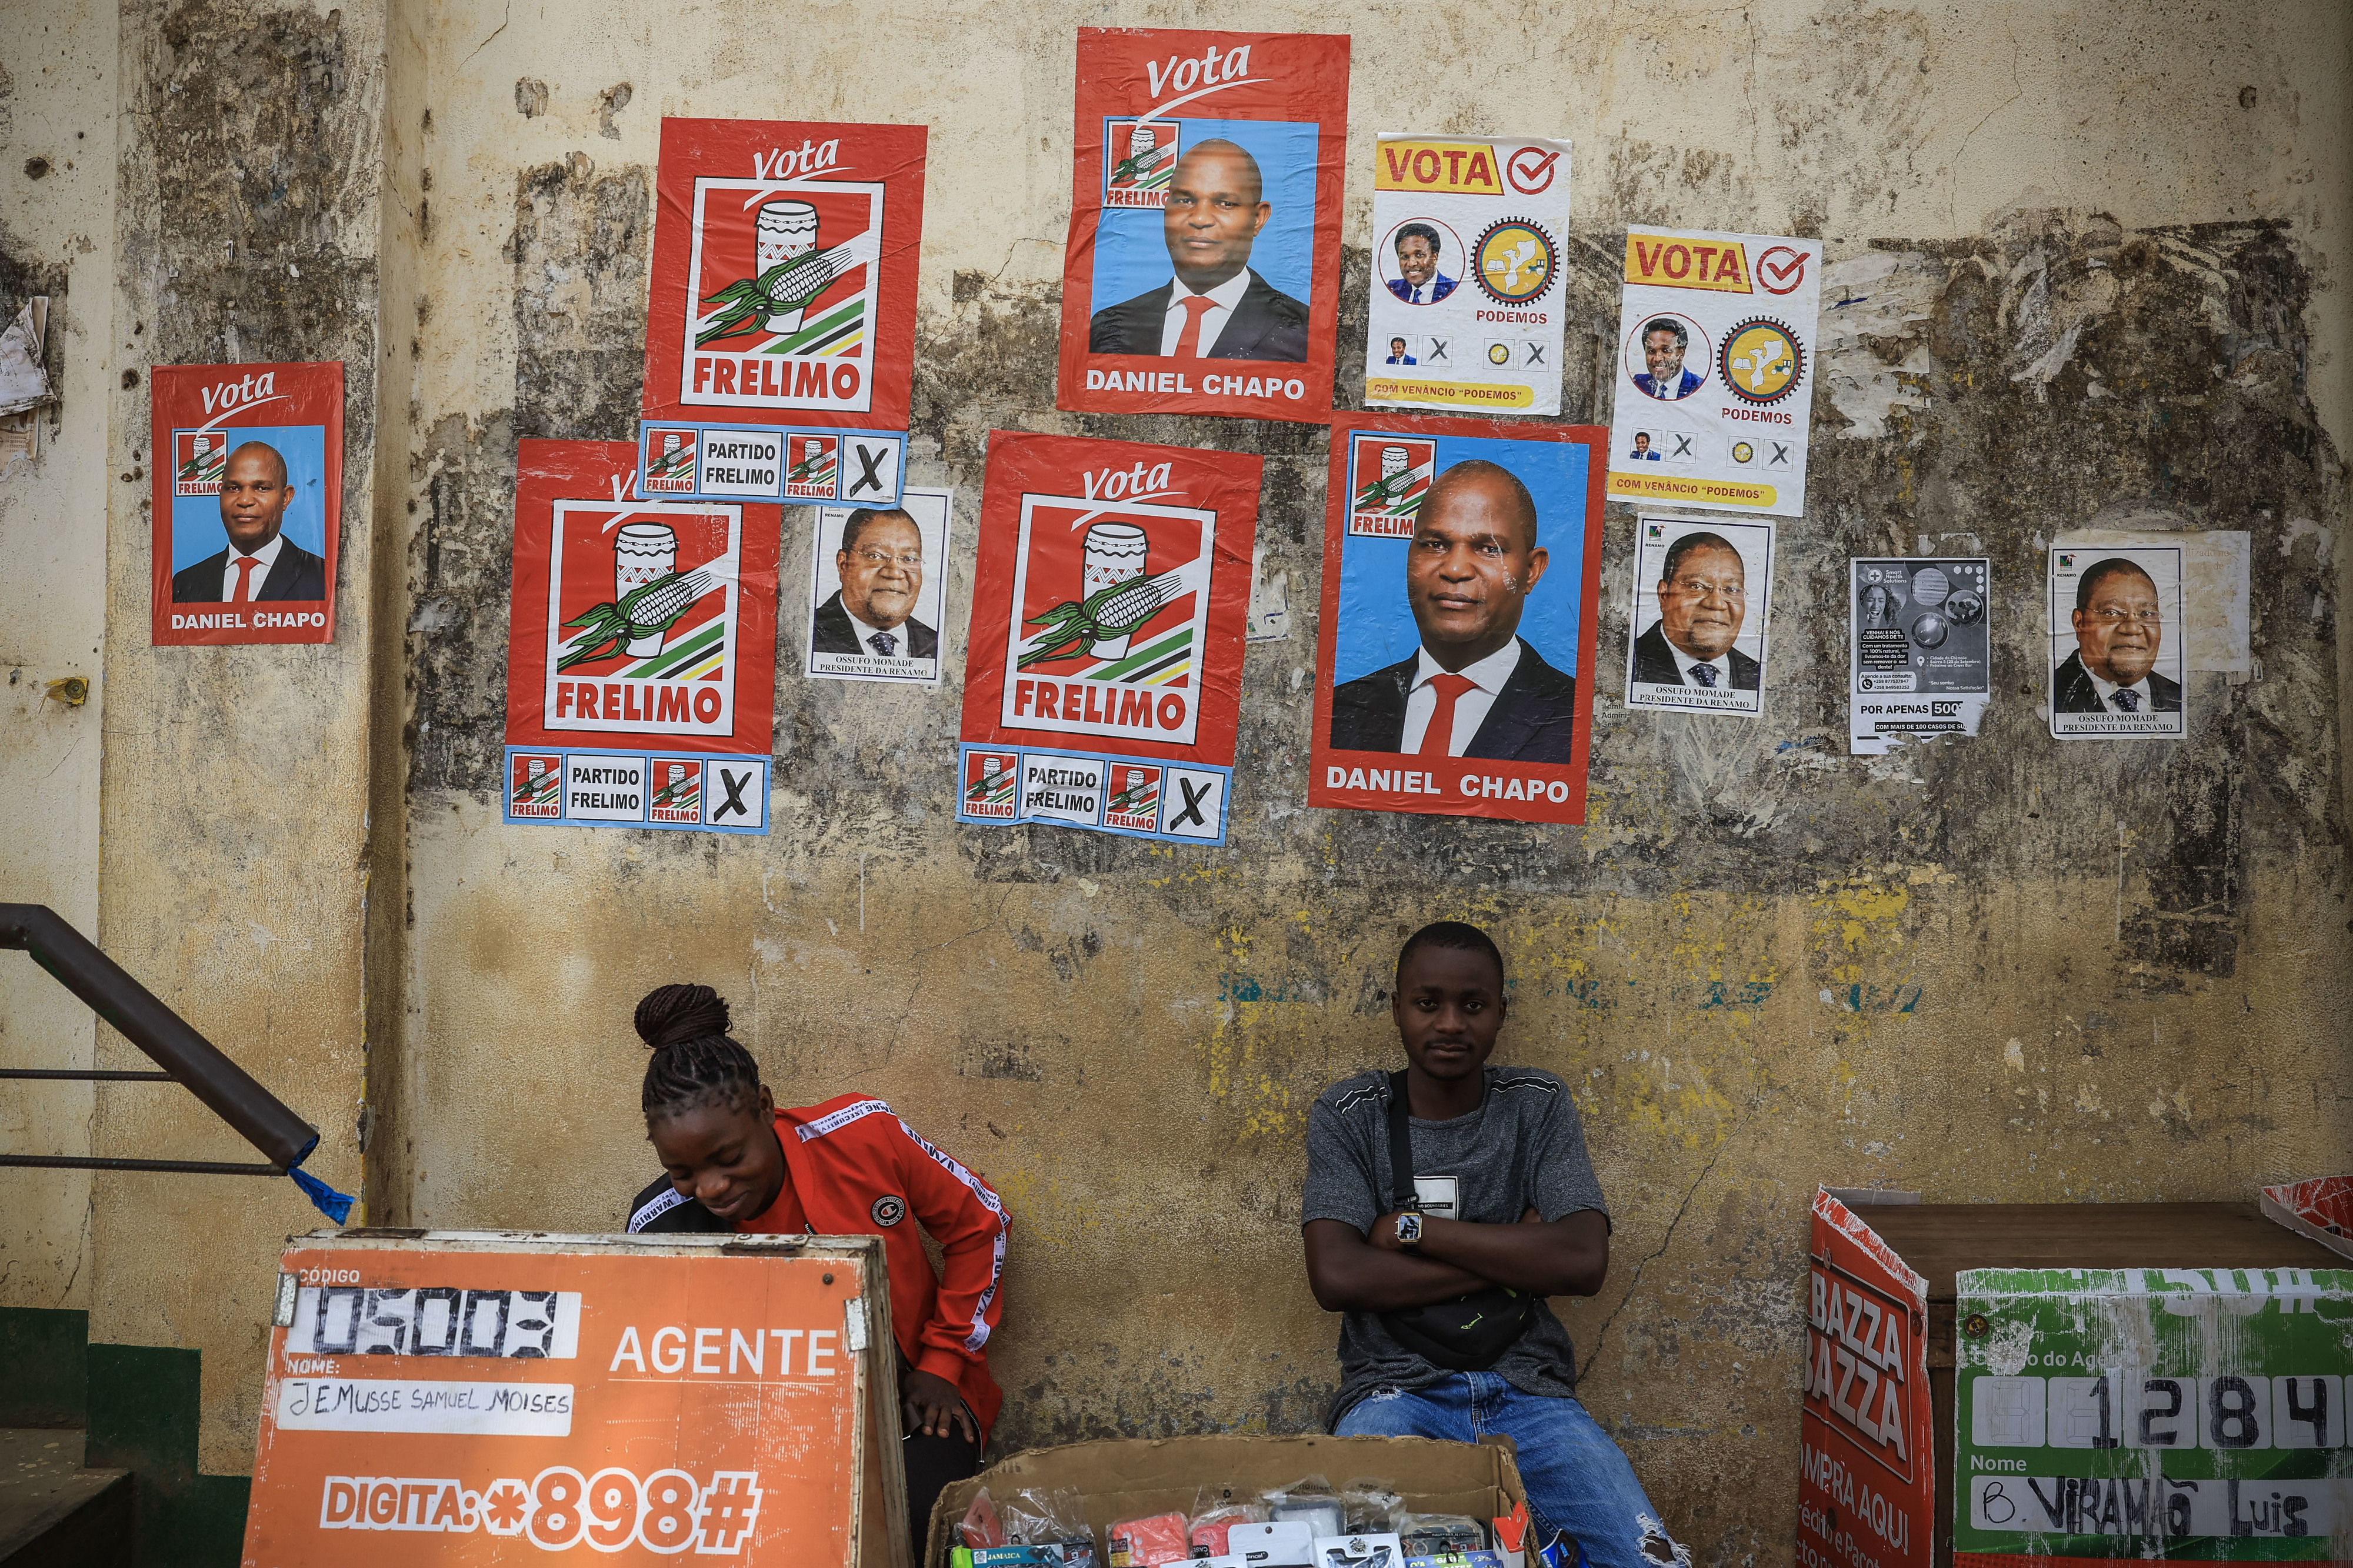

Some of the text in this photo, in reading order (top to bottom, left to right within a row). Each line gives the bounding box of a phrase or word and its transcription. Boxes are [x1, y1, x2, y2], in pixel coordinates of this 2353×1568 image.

[1146, 45, 1251, 98] Vota
[753, 139, 838, 179] Vota
[1385, 148, 1493, 186] VOTA
[1635, 241, 1742, 284] VOTA
[1477, 310, 1547, 324] PODEMOS
[692, 358, 860, 399] FRELIMO
[1086, 369, 1305, 399] DANIEL CHAPO
[201, 372, 275, 414] Vota
[1374, 384, 1398, 394] COM
[1402, 385, 1455, 396] VENÂNCIO
[1722, 408, 1792, 425] PODEMOS
[708, 442, 775, 461] PARTIDO
[646, 478, 692, 491] FRELIMO
[705, 468, 775, 485] FRELIMO
[1082, 462, 1172, 501] Vota
[787, 484, 834, 497] FRELIMO
[1617, 479, 1641, 489] COM
[1645, 480, 1698, 493] VENÂNCIO
[1354, 516, 1413, 536] FRELIM
[171, 612, 325, 629] DANIEL CHAPO
[820, 664, 874, 674] PRESIDENTE
[890, 668, 928, 676] RENAMO
[836, 656, 914, 668] OSSUFO MOMADE
[1656, 686, 1735, 699] OSSUFO MOMADE
[556, 682, 722, 723] FRELIMO
[1014, 680, 1186, 730] FRELIMO
[1639, 694, 1694, 705] PRESIDENTE
[1710, 699, 1749, 709] RENAMO
[1861, 705, 1883, 714] POR
[1886, 705, 1929, 714] APENAS
[2117, 714, 2158, 722] MOMADE
[572, 768, 639, 785] PARTIDO
[1028, 767, 1096, 788] PARTIDO
[1327, 766, 1569, 803] DANIEL CHAPO
[571, 792, 639, 809] FRELIMO
[1026, 793, 1094, 813] FRELIMO
[512, 804, 558, 817] FRELIMO
[651, 809, 698, 822] FRELIMO
[965, 803, 1013, 816] FRELIMO
[1106, 815, 1155, 830] FRELIMO
[299, 1267, 360, 1283] CÓDIGO
[1812, 1270, 1904, 1382] BAZZA
[609, 1327, 836, 1376] AGENTE
[2043, 1350, 2067, 1366] do
[287, 1359, 340, 1374] NOME:
[411, 1387, 480, 1412] SAMUEL
[485, 1389, 569, 1414] MOISES
[2090, 1376, 2327, 1449] 1284
[1970, 1454, 2027, 1471] Nome
[1858, 1483, 1908, 1556] AQUI
[1835, 1532, 1842, 1553] e
[987, 1552, 1021, 1560] JAMAICA
